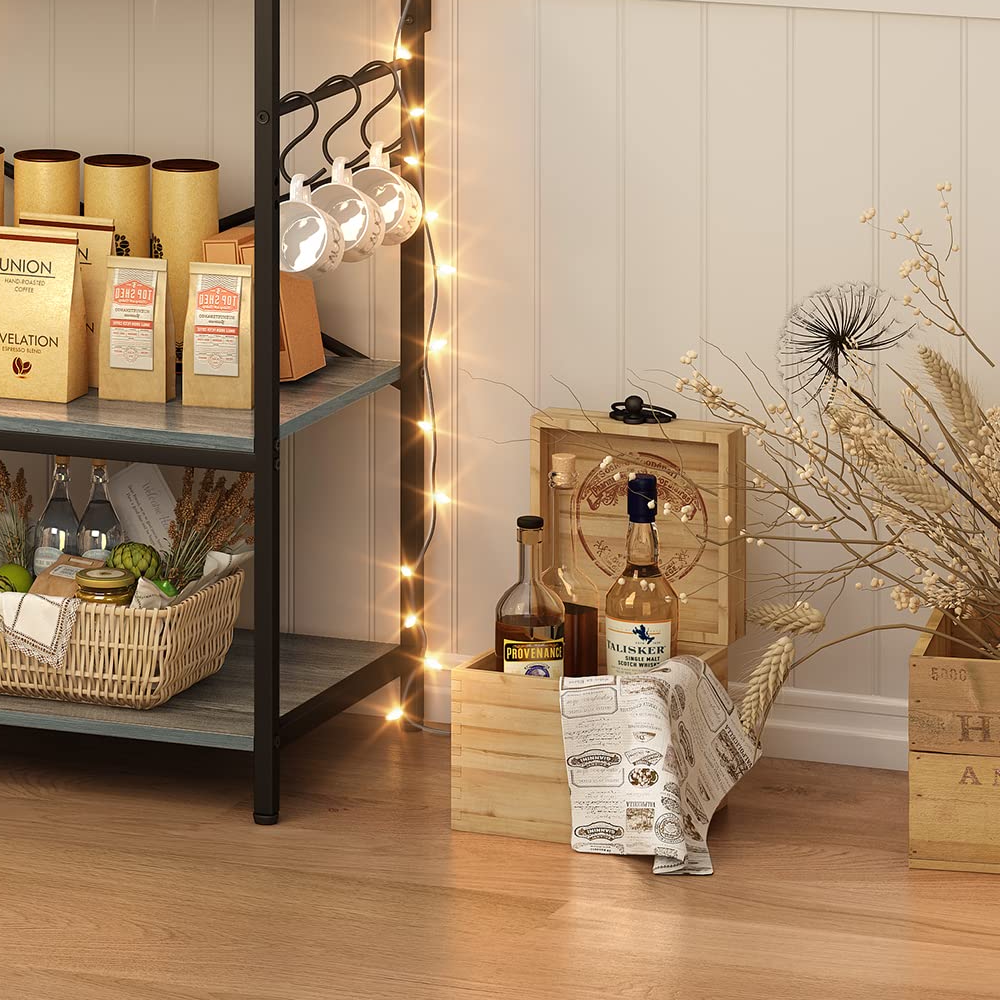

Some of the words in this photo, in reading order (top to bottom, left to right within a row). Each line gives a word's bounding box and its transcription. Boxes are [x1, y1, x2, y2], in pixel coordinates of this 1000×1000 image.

[0, 257, 52, 274] UNION
[4, 278, 46, 286] HAND-ROASTED
[506, 646, 562, 660] PROVENANCE
[607, 640, 665, 655] TALISKER
[617, 660, 638, 668] SCOTCH
